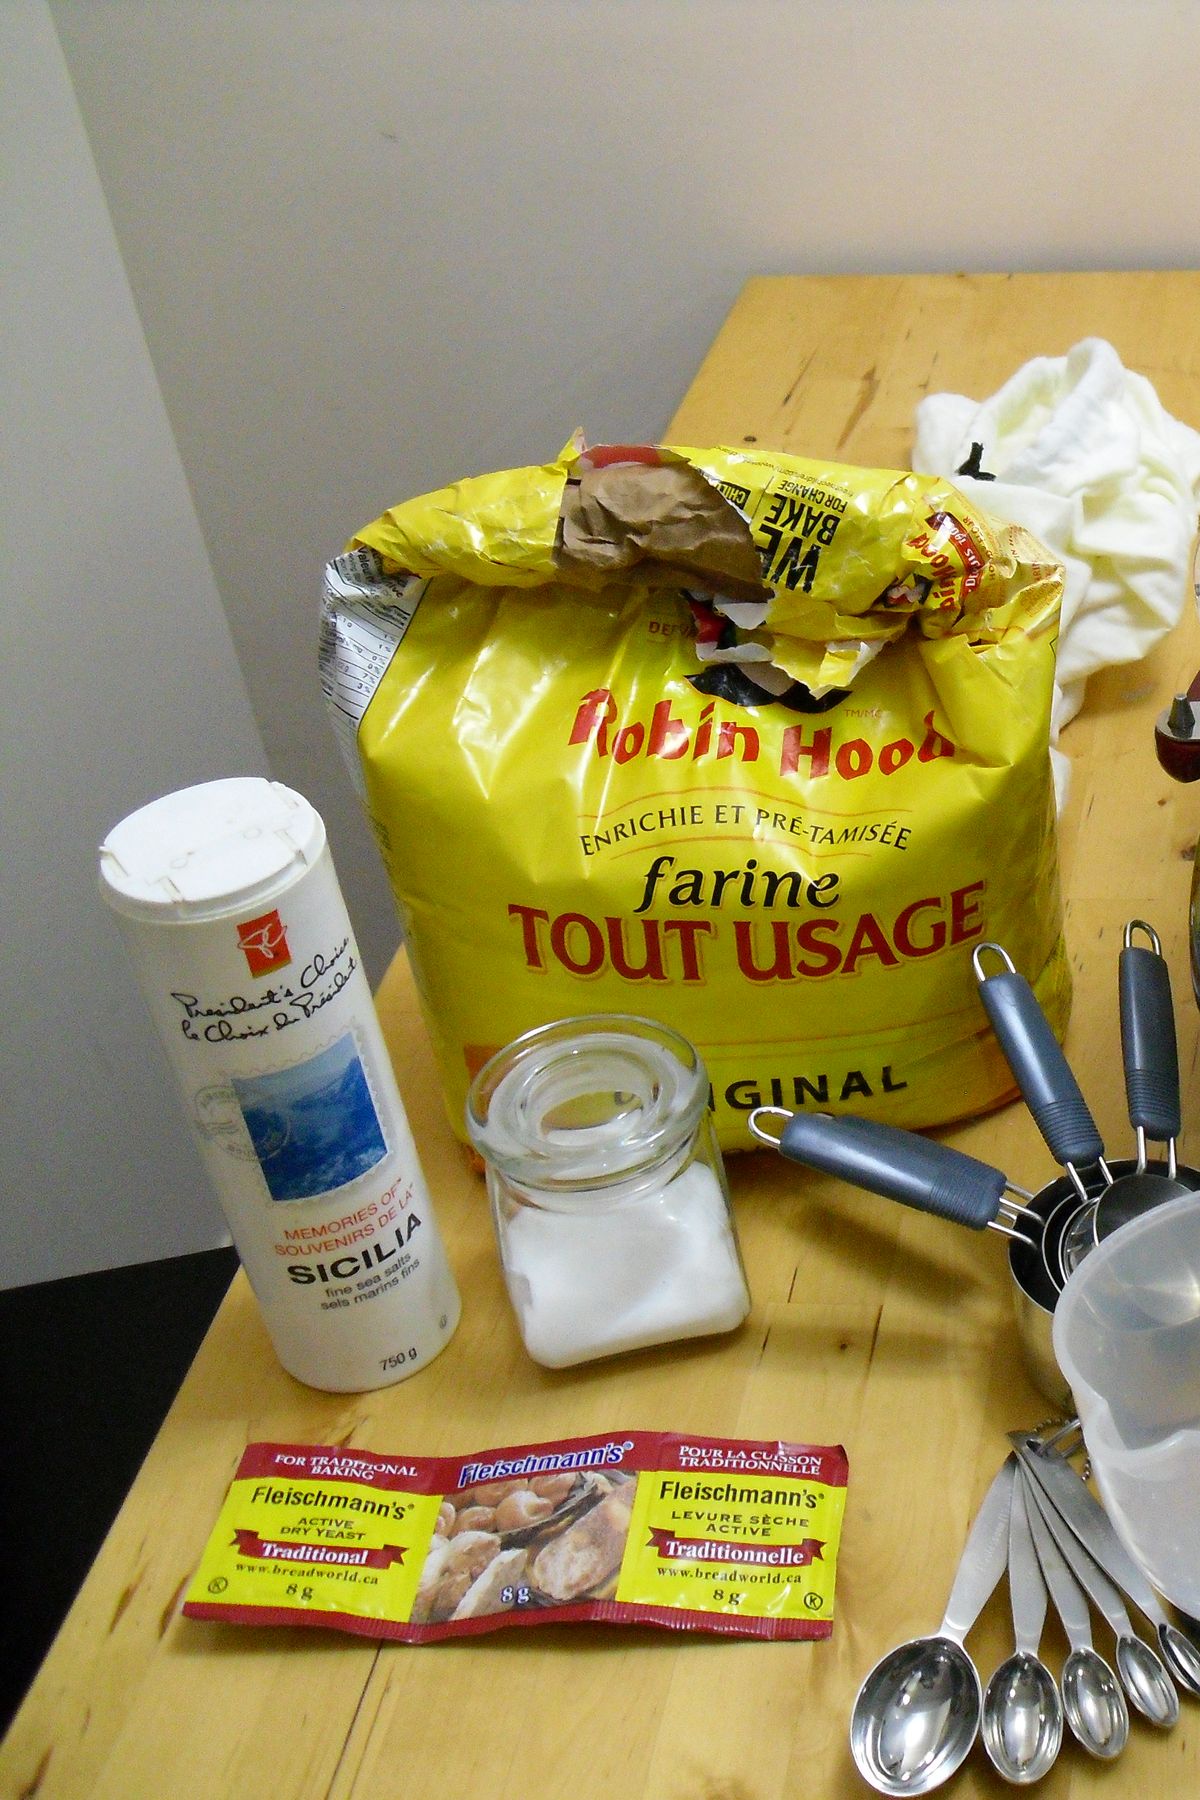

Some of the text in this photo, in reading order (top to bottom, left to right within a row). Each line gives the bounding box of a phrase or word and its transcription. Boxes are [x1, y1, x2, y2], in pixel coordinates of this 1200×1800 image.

[714, 483, 746, 504] CHIL
[777, 480, 826, 505] CHANGE
[824, 497, 848, 513] FOR
[763, 492, 841, 546] BAKE
[755, 523, 822, 593] WE
[567, 688, 955, 781] Robin Hood
[579, 804, 913, 857] ENRICHIE ET PRÉ-TAMISÉE
[633, 856, 842, 914] farine
[507, 881, 986, 981] TOUT USAGE
[171, 985, 294, 1018] President's
[204, 1020, 269, 1042] Choix
[275, 1189, 414, 1256] SOUVENIRS DE LA
[284, 1186, 398, 1241] MEMORIES OF
[287, 1212, 422, 1285] SICILIA
[321, 1259, 420, 1311] sels marins fins
[326, 1253, 412, 1298] fine sea salts
[379, 1347, 418, 1372] 750 g
[275, 1453, 418, 1477] FOR TRADITIONAL
[458, 1443, 625, 1488] Fleischmann's
[679, 1445, 823, 1466] POUR LA CUISSON
[679, 1456, 821, 1475] TRADITIONNELLE
[311, 1466, 375, 1481] BAKING
[251, 1486, 407, 1520] Fleischmann's
[659, 1481, 818, 1509] Fleischmann's
[298, 1516, 355, 1530] ACTIVE
[671, 1510, 809, 1528] LEVURE SÈCHE
[706, 1523, 771, 1537] ACTIVE
[280, 1526, 367, 1541] DRY YEAST
[262, 1542, 368, 1565] Traditional
[666, 1541, 804, 1565] Traditionnelle
[235, 1562, 379, 1585] www.breadworld.ca
[657, 1566, 802, 1584] www.breadworld.ca
[286, 1582, 314, 1601] 8 g
[502, 1586, 530, 1604] 8 g
[713, 1588, 743, 1606] 8 g
